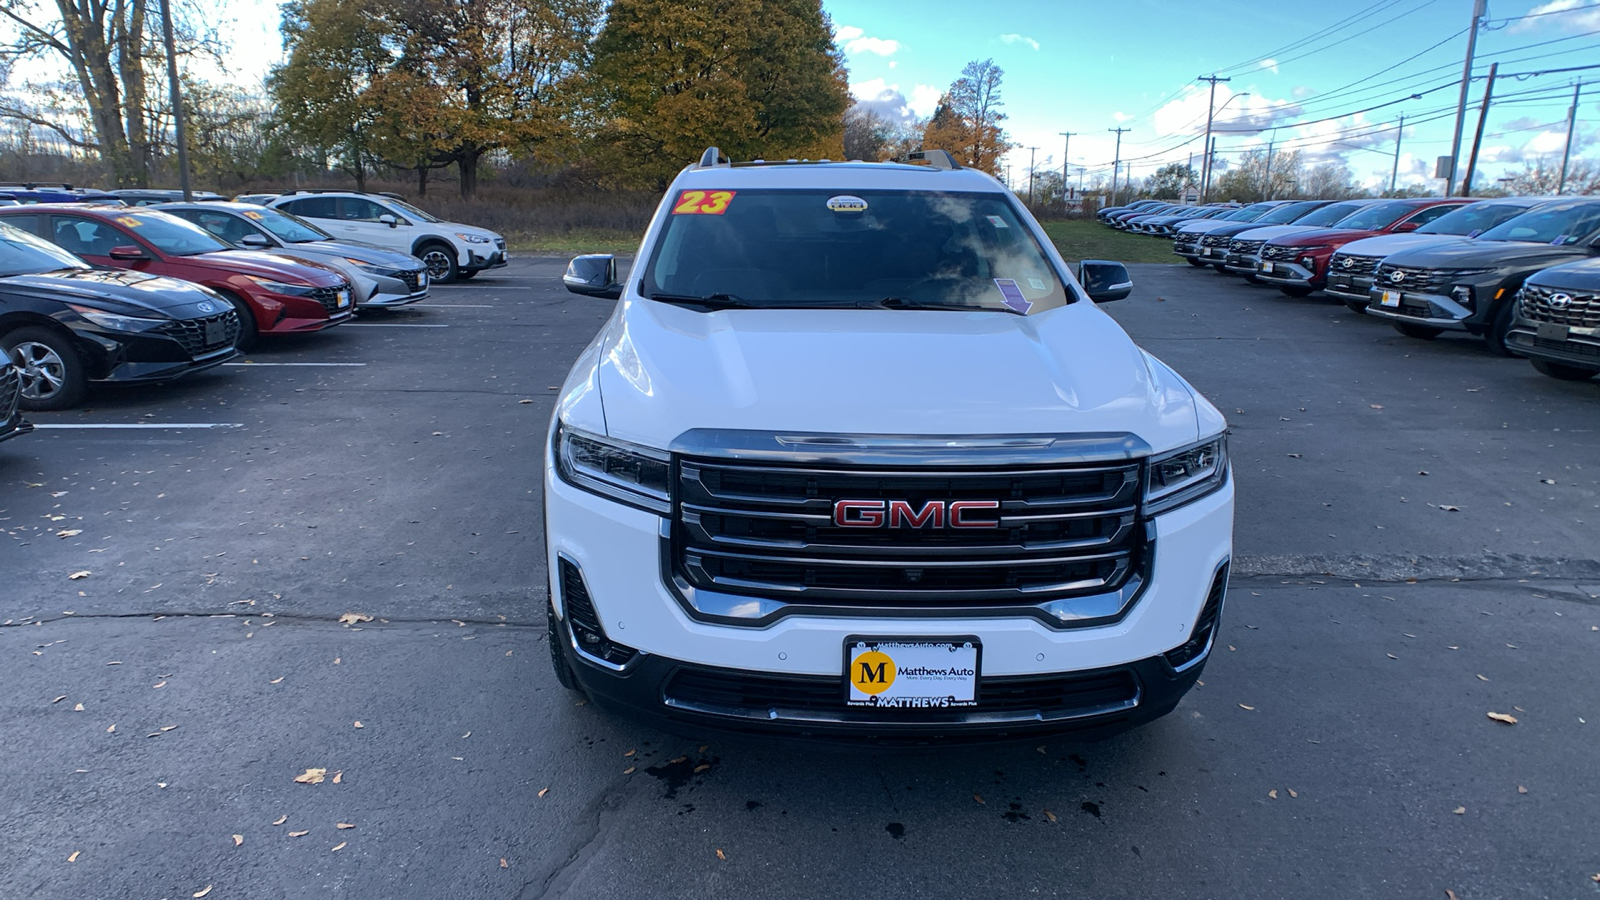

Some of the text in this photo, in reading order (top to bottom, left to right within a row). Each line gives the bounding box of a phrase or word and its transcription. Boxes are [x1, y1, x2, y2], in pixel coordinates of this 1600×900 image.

[675, 190, 732, 214] 23
[834, 500, 999, 529] GMC
[876, 641, 953, 649] MatthewsAuto.com
[857, 662, 889, 684] M
[897, 666, 974, 676] Matthews Auto
[876, 697, 949, 708] MATTHEWS
